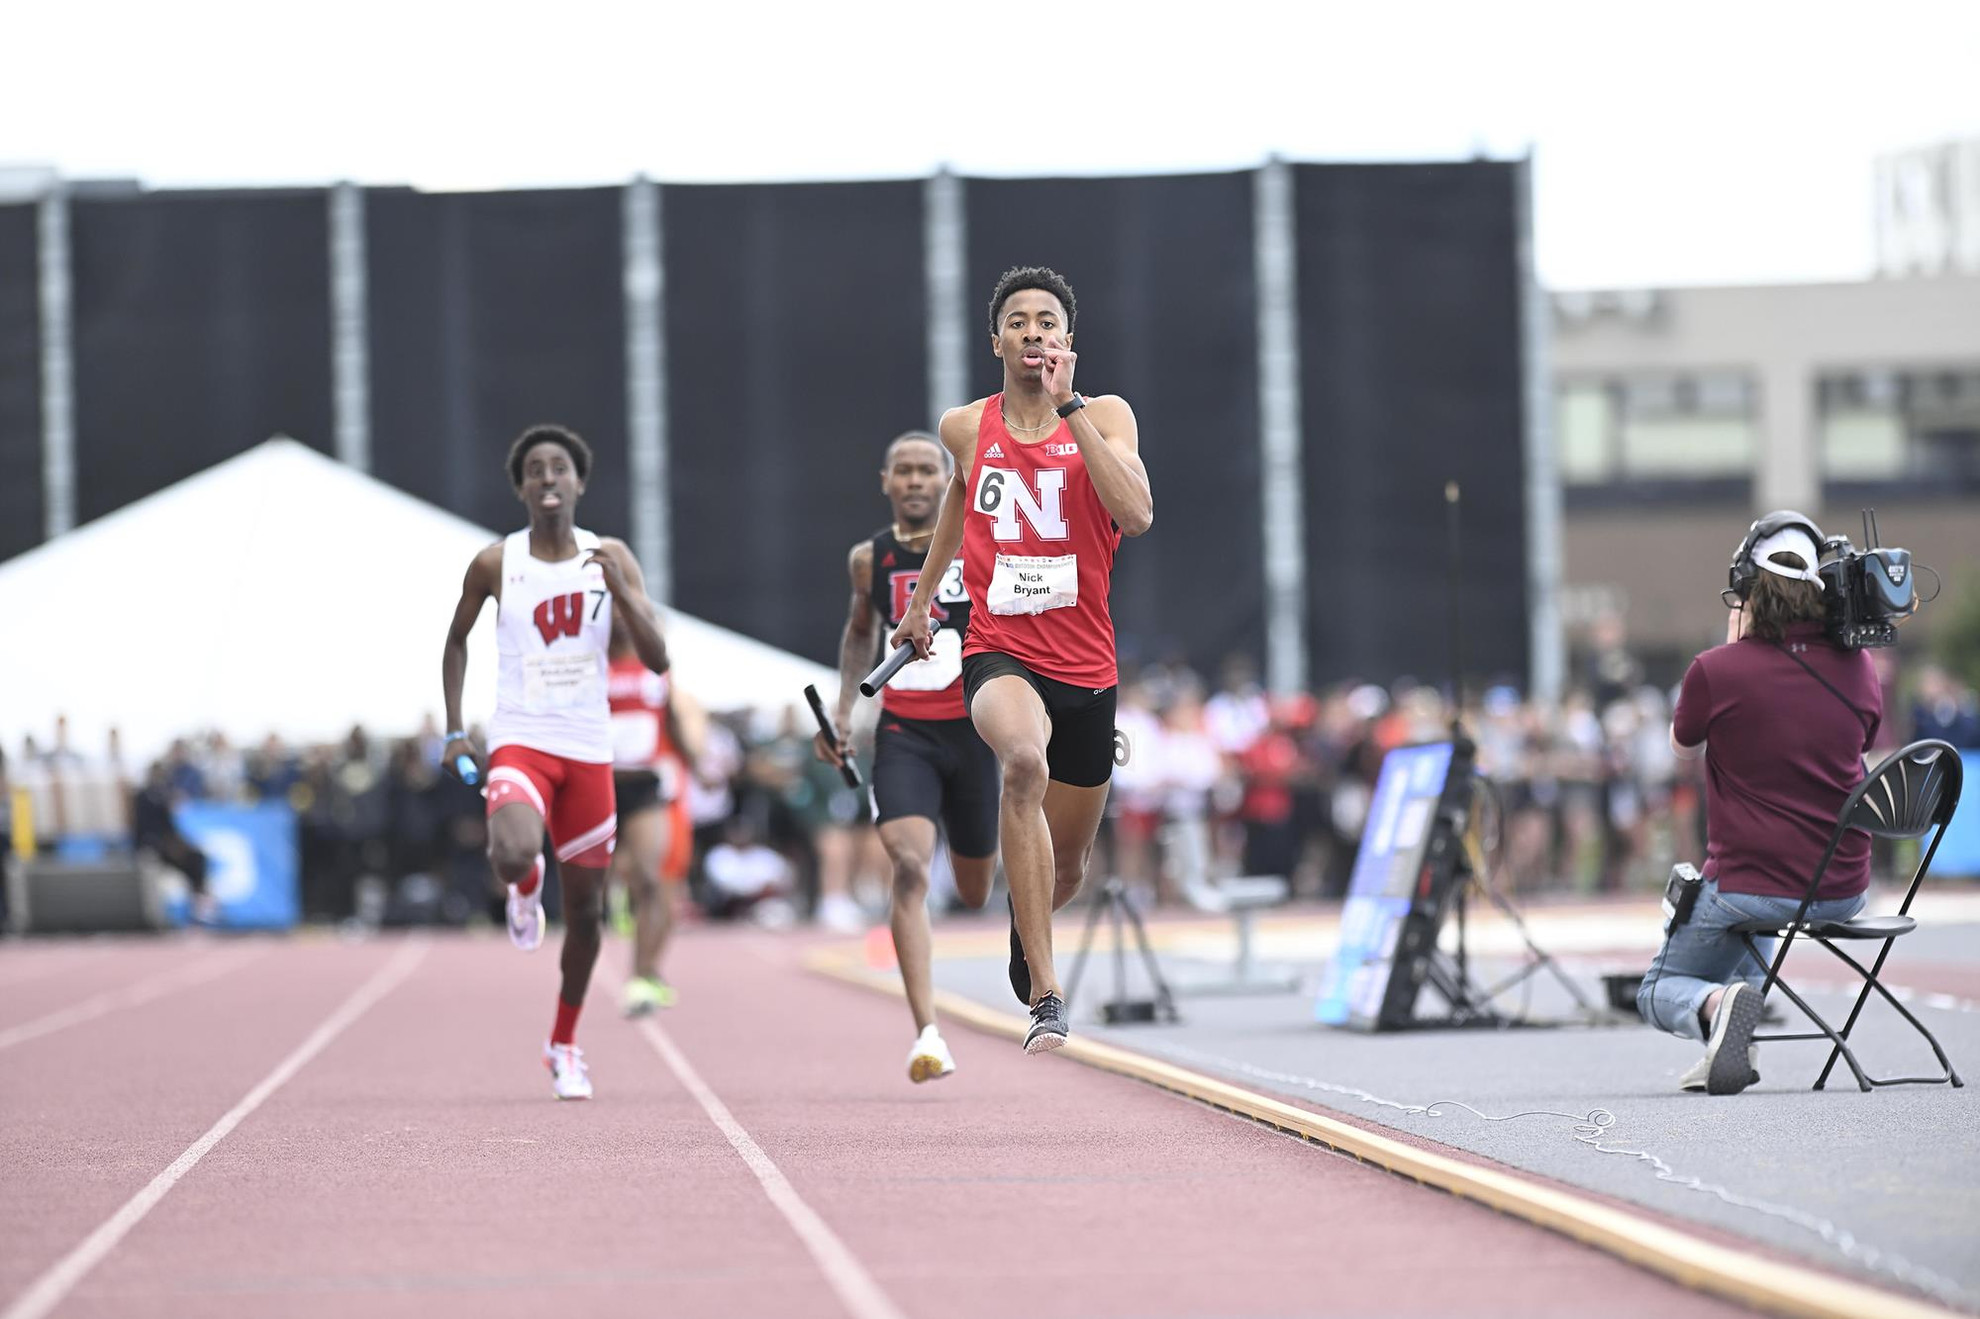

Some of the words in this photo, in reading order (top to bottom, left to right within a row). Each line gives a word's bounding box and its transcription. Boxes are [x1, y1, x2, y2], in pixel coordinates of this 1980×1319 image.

[979, 471, 1005, 513] 6
[991, 467, 1070, 543] N
[945, 566, 964, 597] 3
[1014, 584, 1051, 597] Bryant
[1019, 572, 1043, 582] Nick
[533, 591, 584, 648] W
[589, 590, 605, 621] 7
